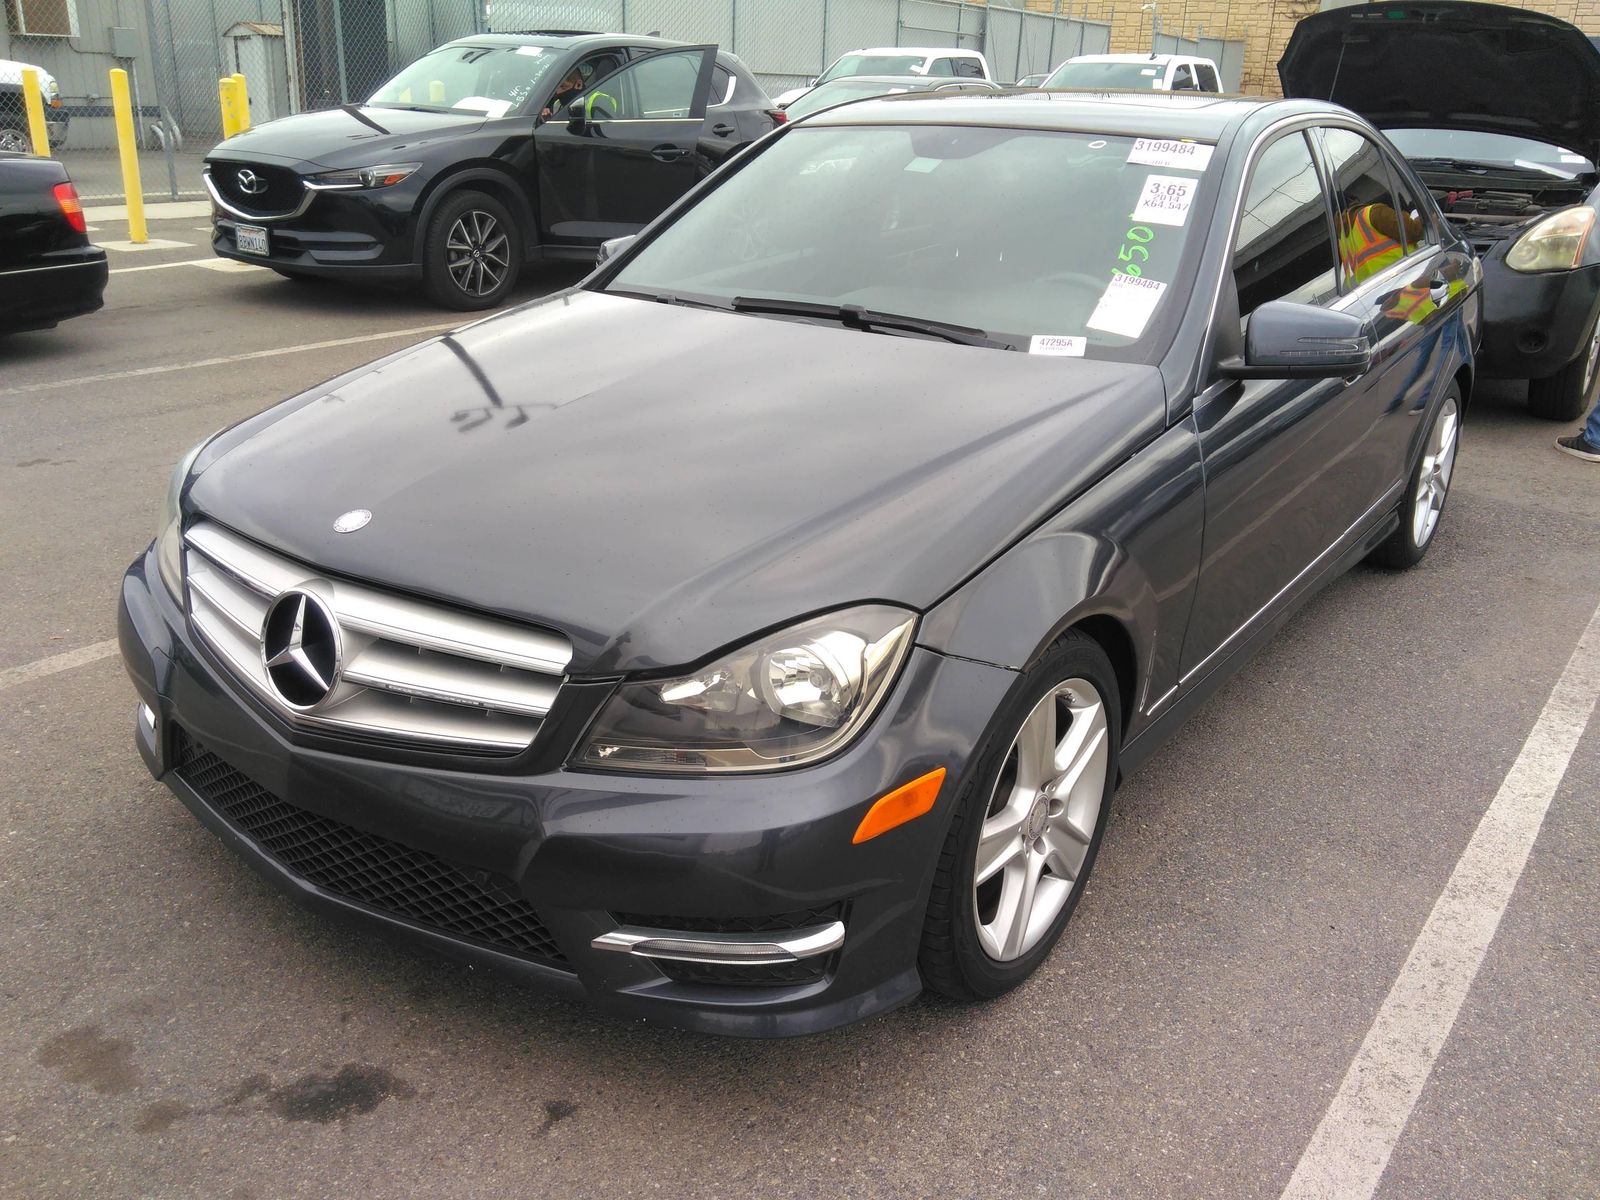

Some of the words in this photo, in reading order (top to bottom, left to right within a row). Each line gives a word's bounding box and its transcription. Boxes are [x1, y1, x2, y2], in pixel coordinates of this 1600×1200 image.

[1135, 140, 1196, 155] 3199484
[1153, 194, 1180, 203] 2014
[1114, 273, 1161, 290] 3199484
[1039, 338, 1073, 347] 47295A
